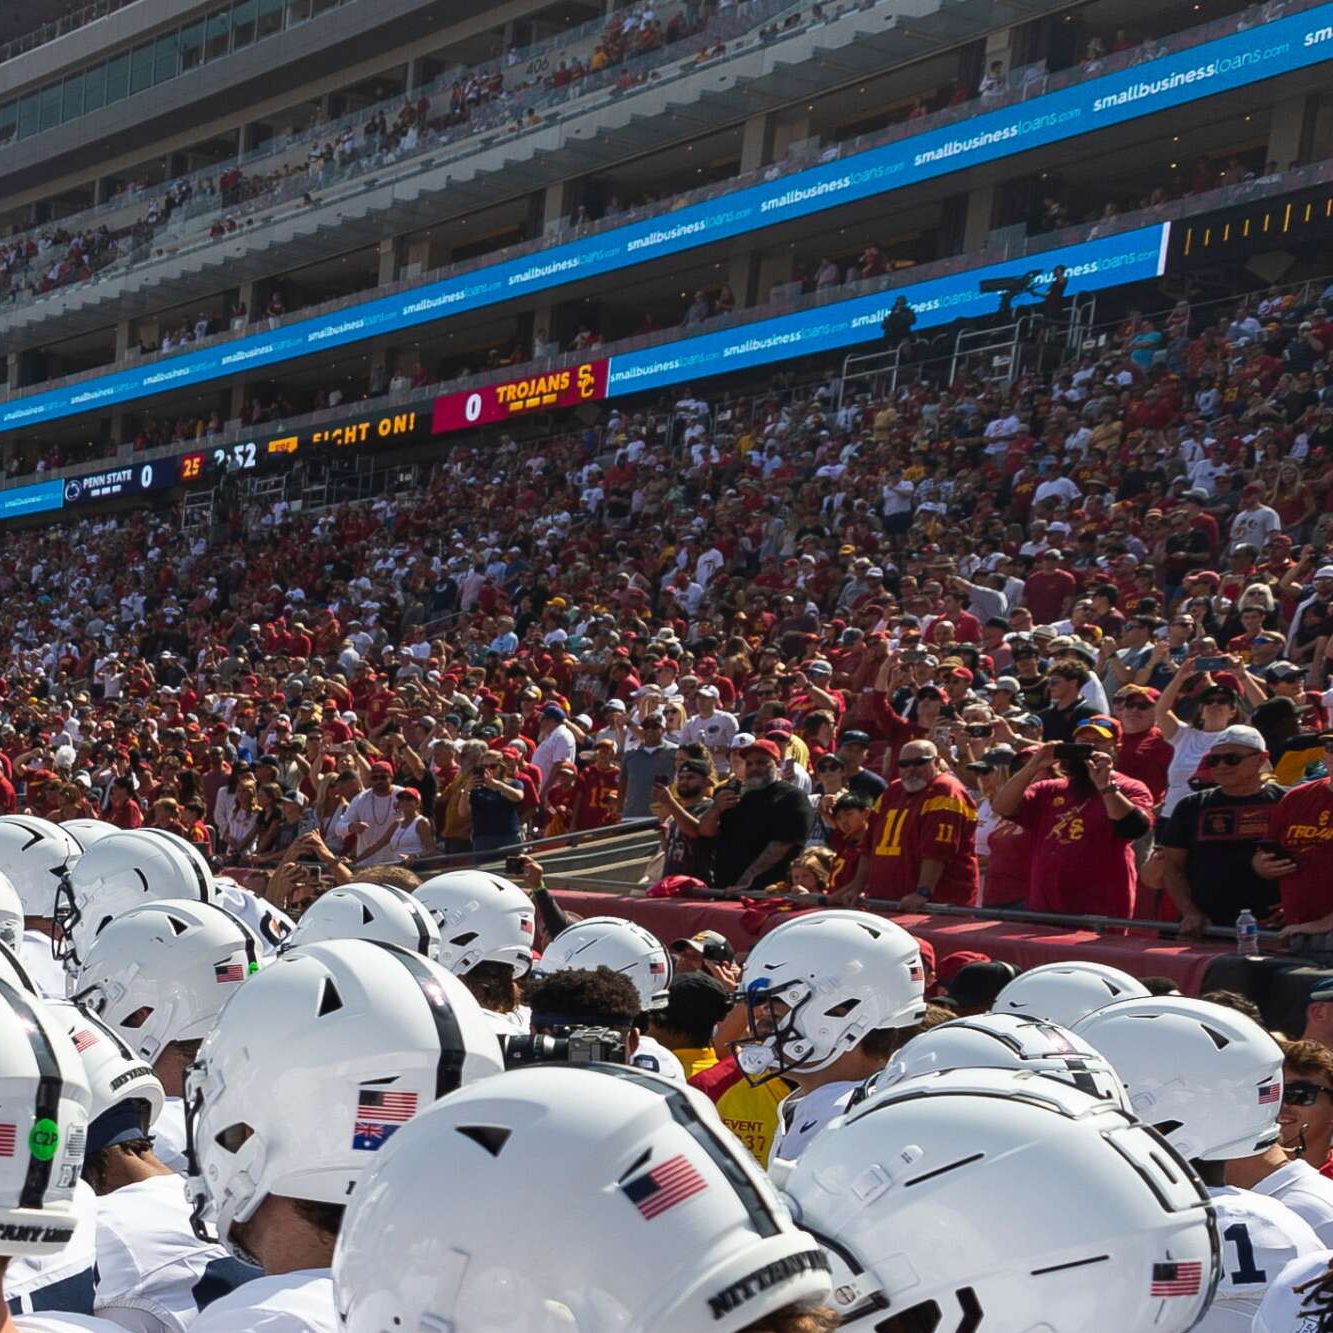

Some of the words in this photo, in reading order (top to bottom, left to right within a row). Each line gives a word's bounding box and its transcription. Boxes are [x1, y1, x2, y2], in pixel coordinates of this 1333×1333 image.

[1093, 43, 1290, 112] smallbusinessloans.com
[914, 108, 1082, 166] smallbusinessloans.com
[761, 162, 905, 212] smallbusinessloans.com
[627, 208, 753, 252] smallbusinessloans.com
[465, 393, 481, 421] 0
[496, 371, 570, 404] TROJANS
[378, 412, 417, 437] ON!
[83, 471, 105, 488] PENN
[106, 468, 133, 483] STATE
[141, 465, 153, 488] 0
[875, 808, 910, 857] 11
[935, 823, 953, 842] 11
[35, 1129, 57, 1147] C2P
[1220, 1223, 1267, 1285] 1
